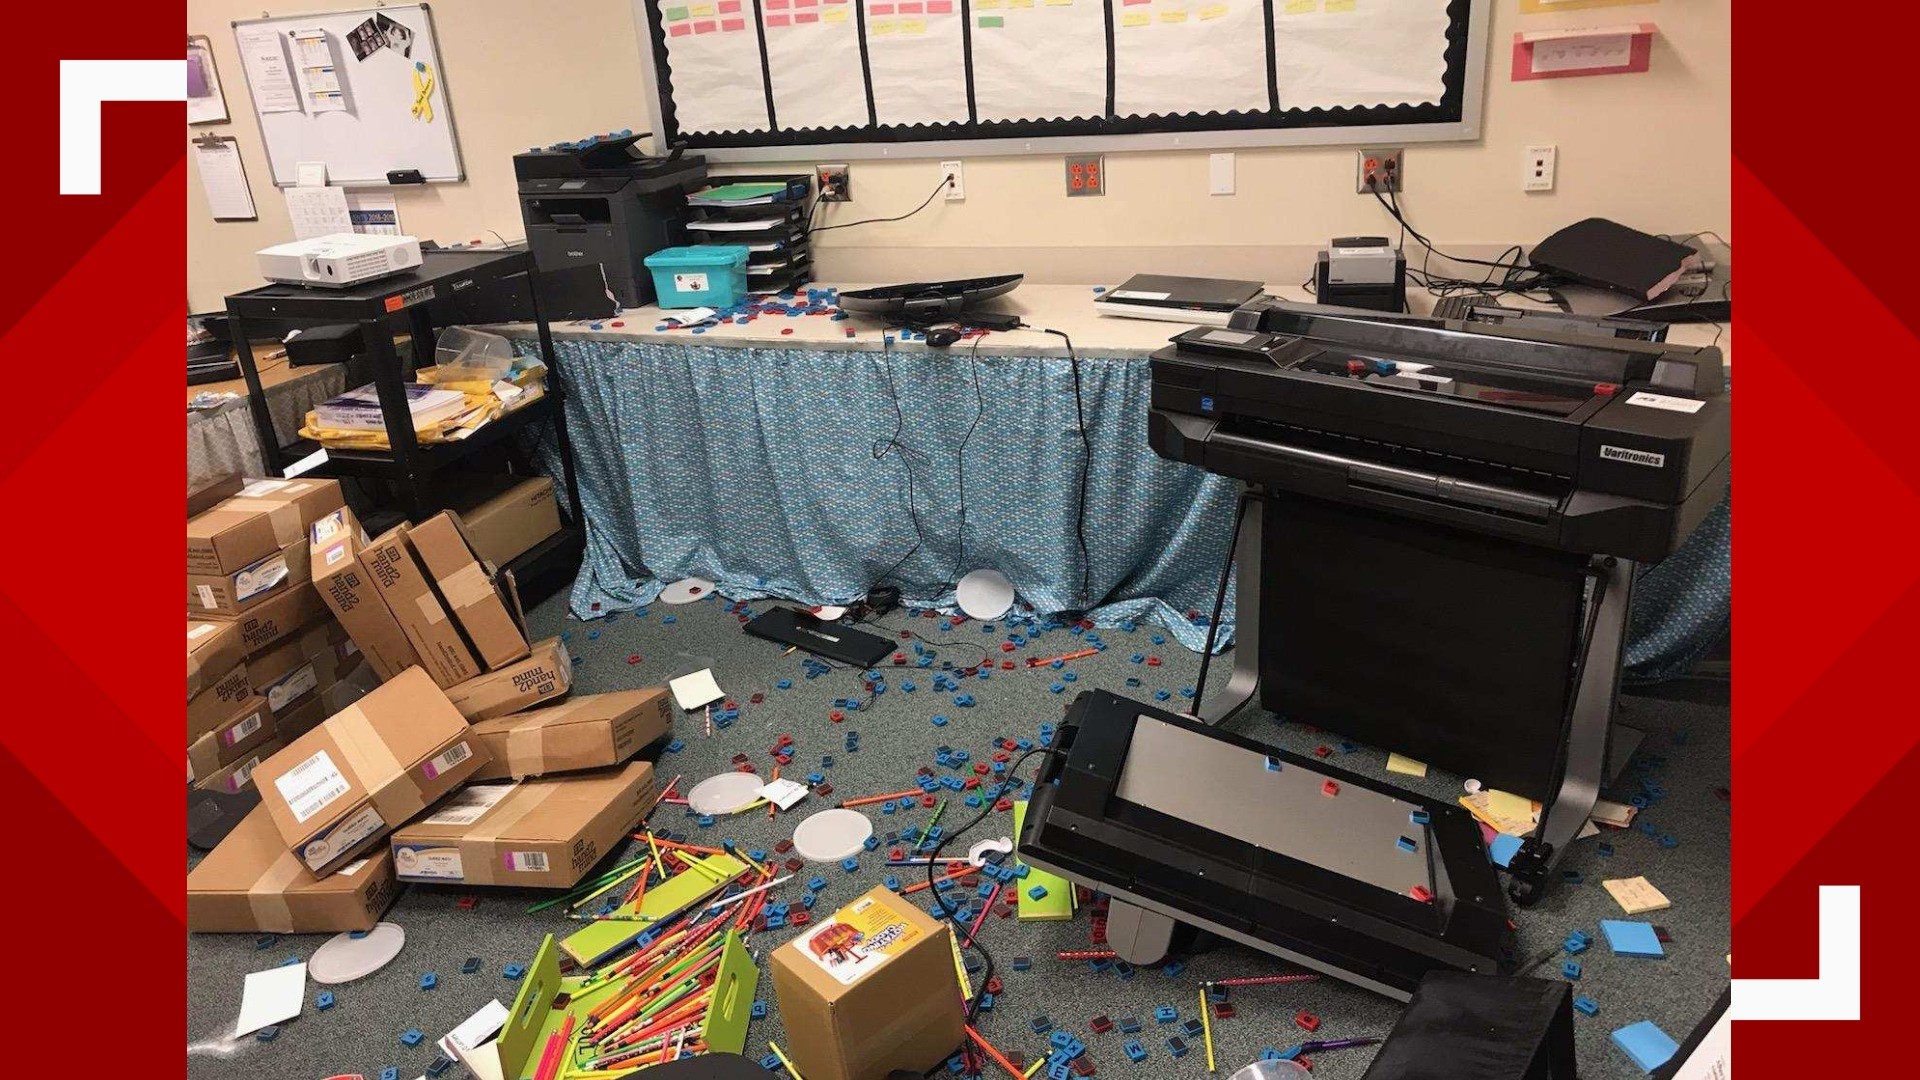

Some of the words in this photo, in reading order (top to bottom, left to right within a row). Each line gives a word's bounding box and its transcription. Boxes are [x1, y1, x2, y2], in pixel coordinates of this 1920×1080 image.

[1603, 446, 1662, 466] Varitronics
[371, 559, 395, 588] mind
[374, 546, 401, 581] hand2
[328, 586, 354, 613] mind
[332, 573, 360, 605] hand2
[511, 667, 544, 687] mind
[519, 671, 556, 692] hand2
